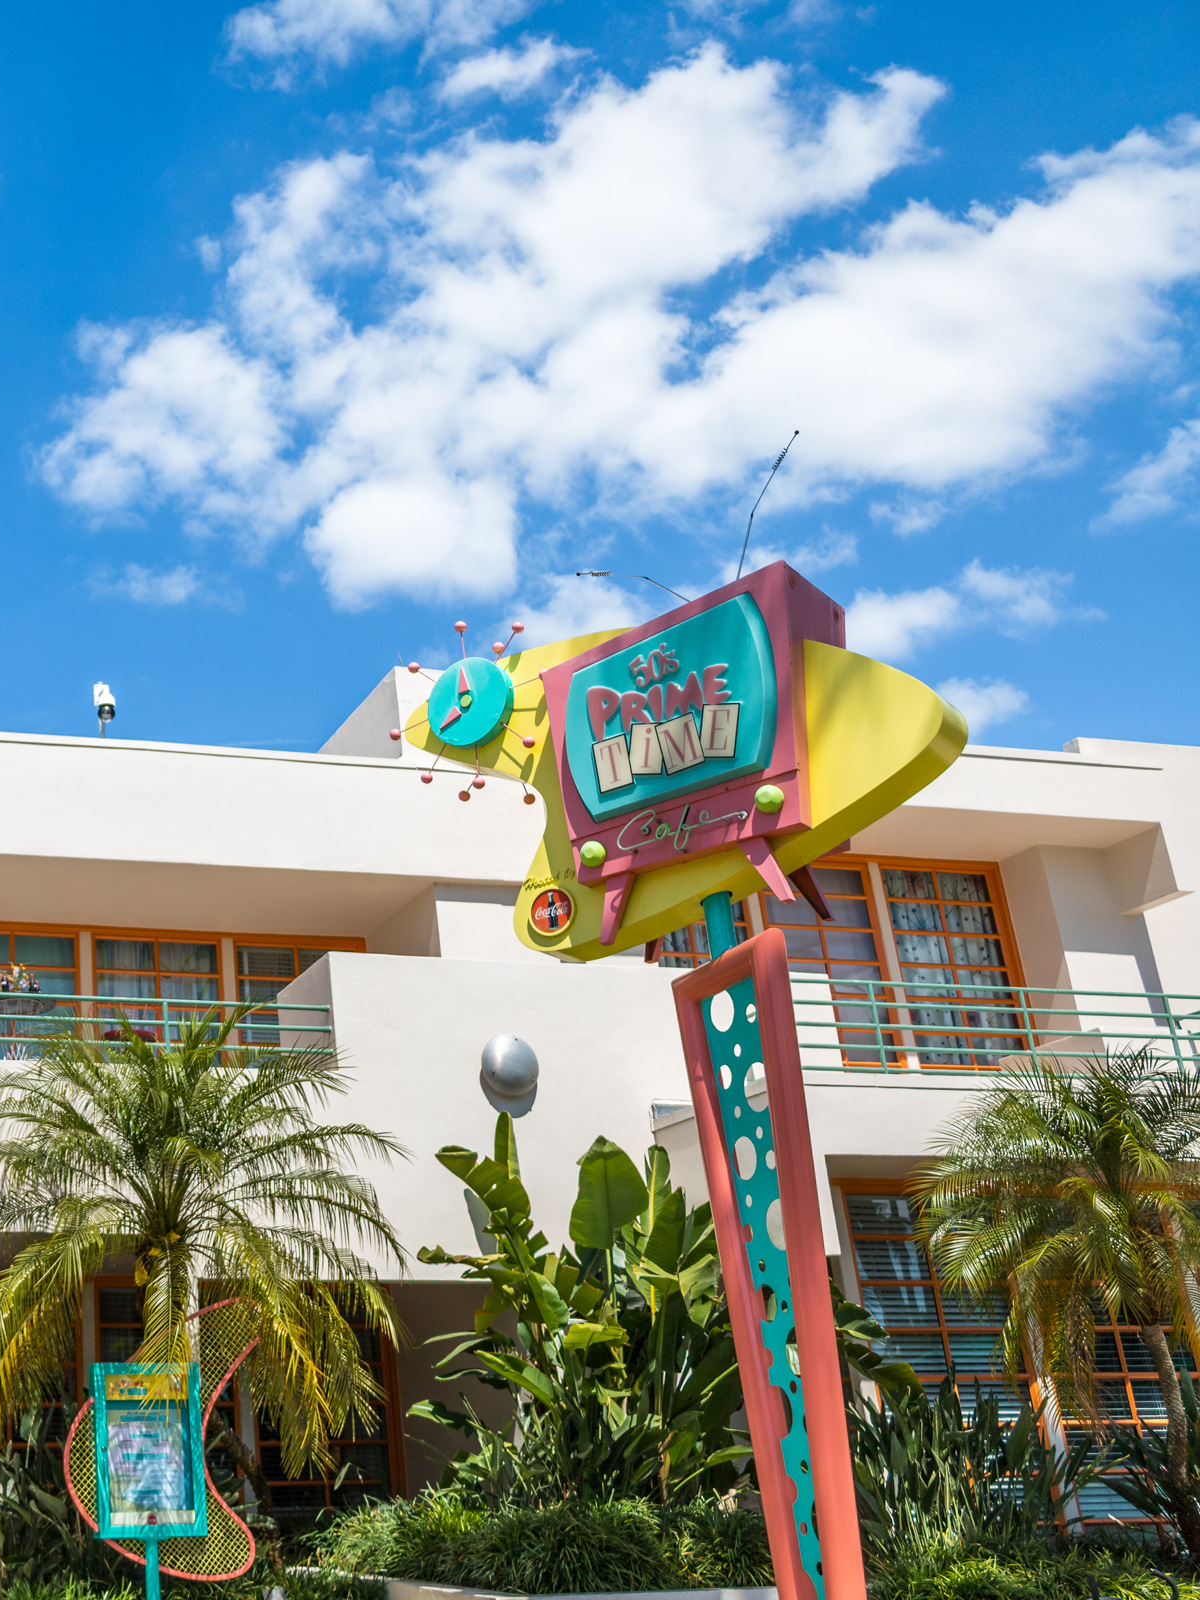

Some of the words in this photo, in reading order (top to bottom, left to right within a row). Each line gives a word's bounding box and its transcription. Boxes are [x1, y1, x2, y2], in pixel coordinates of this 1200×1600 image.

[629, 643, 679, 687] 50's
[587, 664, 732, 742] PRIME
[617, 803, 744, 851] Cafe
[535, 901, 569, 920] Coca-Cola
